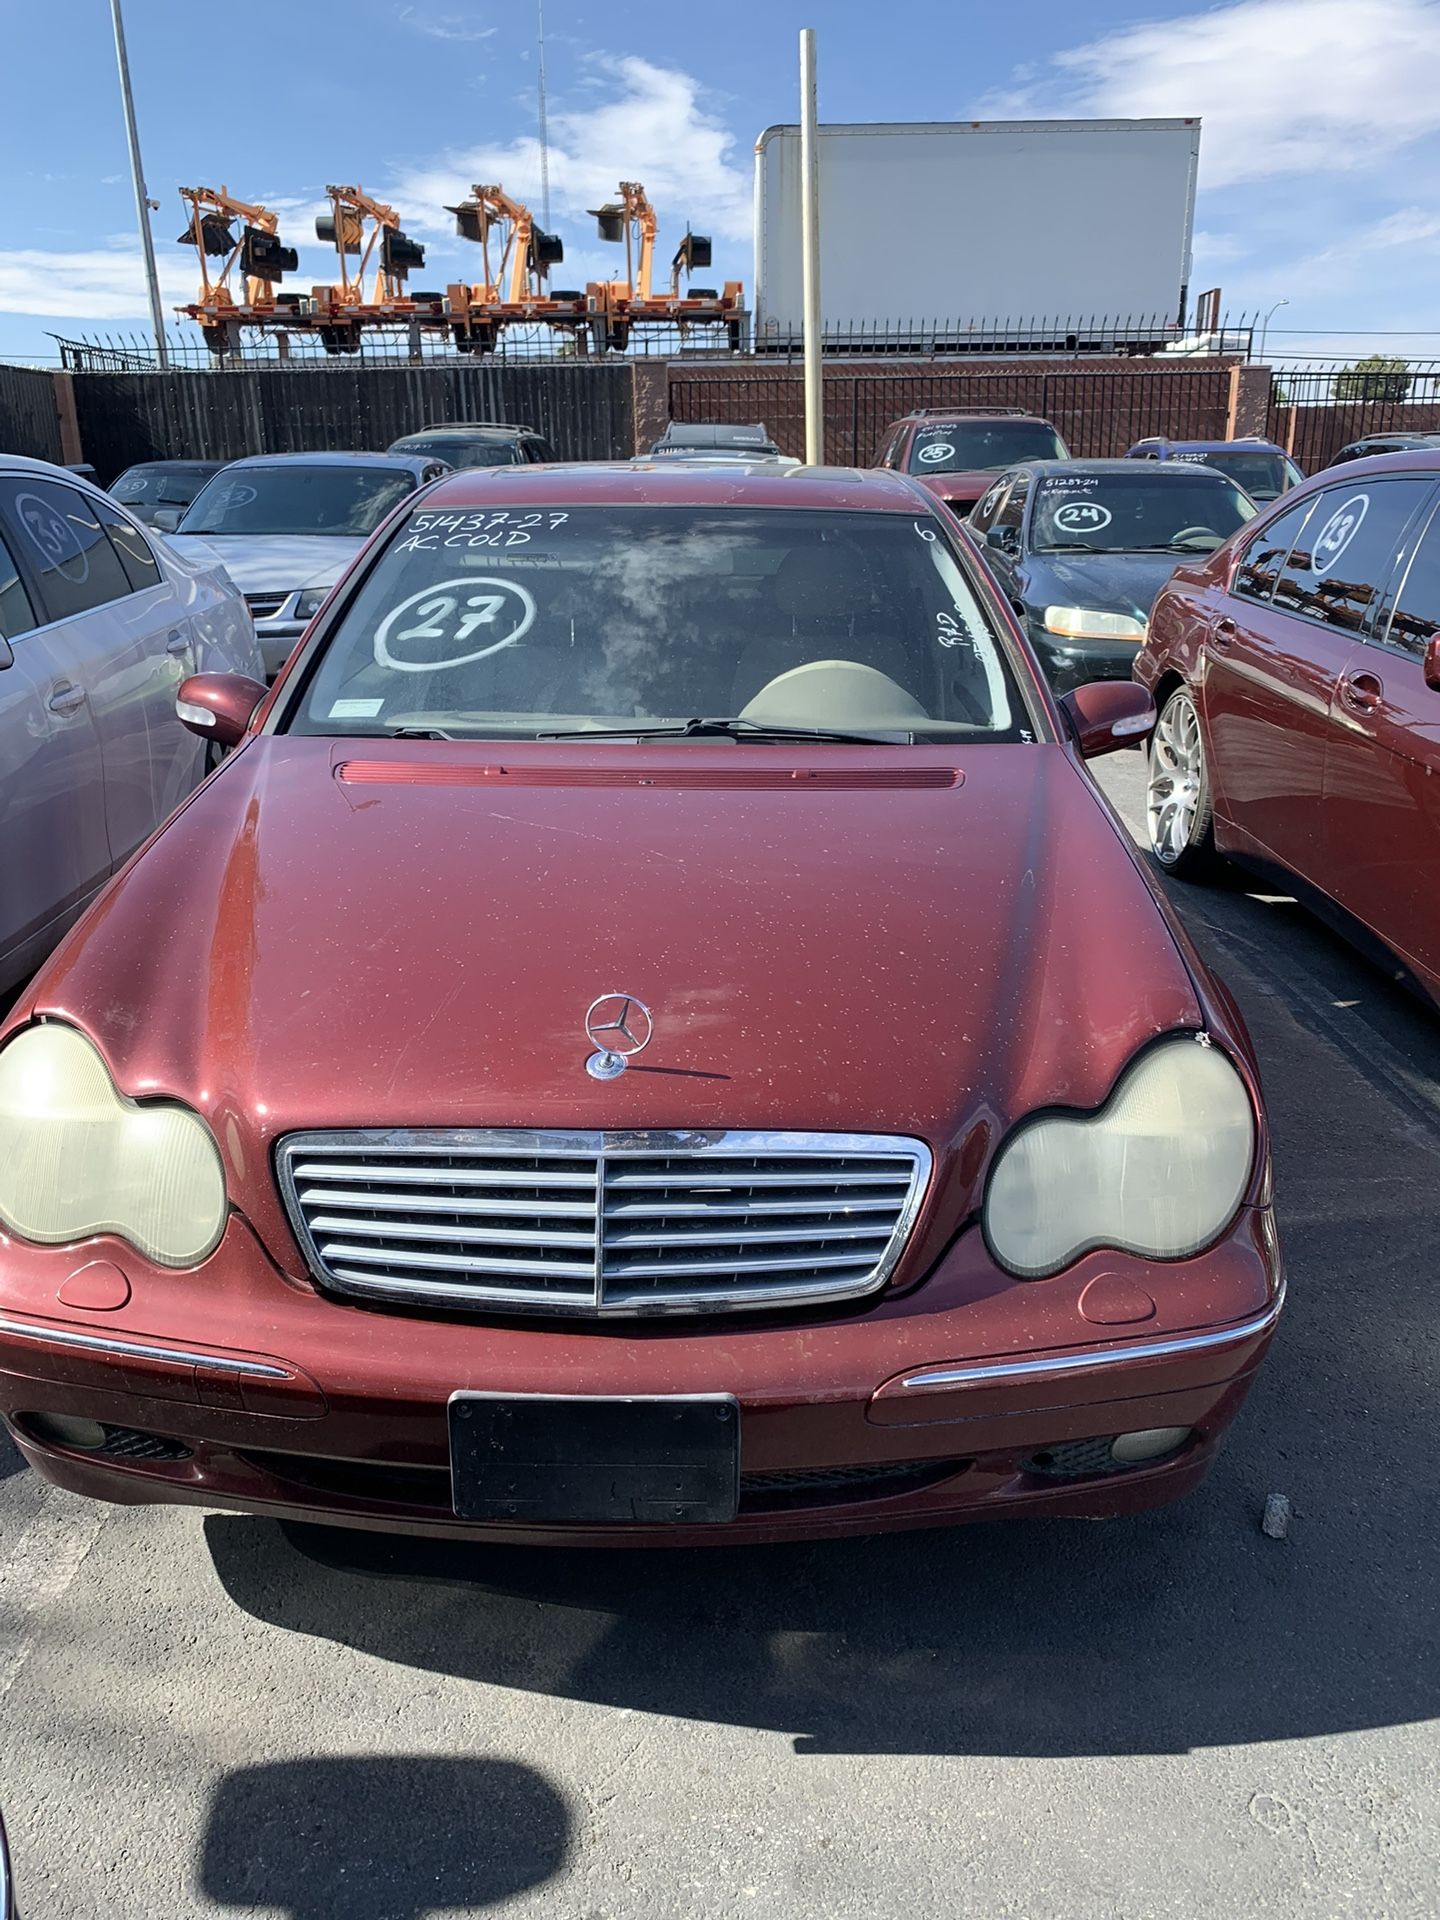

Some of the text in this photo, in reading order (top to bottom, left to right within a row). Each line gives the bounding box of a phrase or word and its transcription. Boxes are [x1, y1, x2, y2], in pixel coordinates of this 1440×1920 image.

[408, 512, 570, 534] 51437-27
[1061, 508, 1100, 522] 24
[444, 531, 532, 547] COLD
[396, 595, 506, 641] 27
